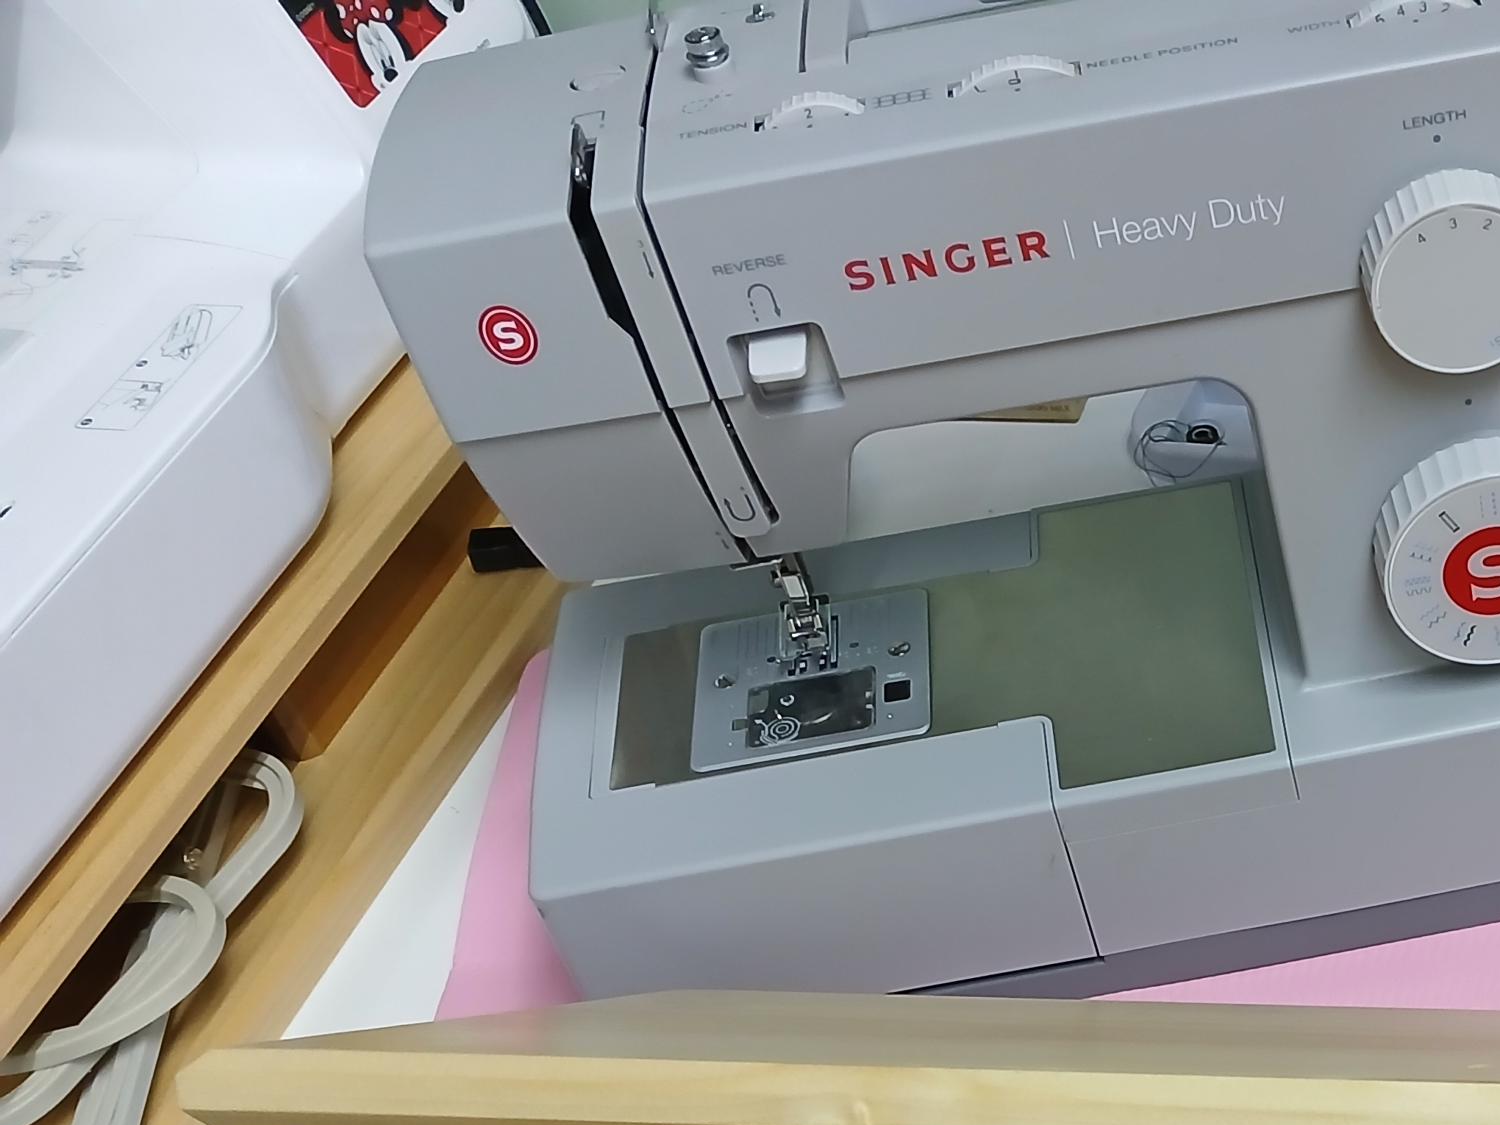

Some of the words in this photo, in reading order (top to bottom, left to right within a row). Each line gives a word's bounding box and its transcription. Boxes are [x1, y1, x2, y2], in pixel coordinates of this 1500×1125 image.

[1287, 19, 1341, 34] WIDTH
[1086, 51, 1153, 70] NEEDLE
[1157, 36, 1239, 57] POSITION
[679, 121, 748, 140] TENSION
[1402, 109, 1467, 131] LENGTH
[1416, 233, 1427, 245] 4
[1450, 217, 1458, 230] 3
[1482, 218, 1494, 231] 2
[843, 230, 1051, 292] SINGER
[1092, 210, 1197, 250] Heavy
[1207, 194, 1285, 230] Duty
[711, 254, 788, 276] REVERSE
